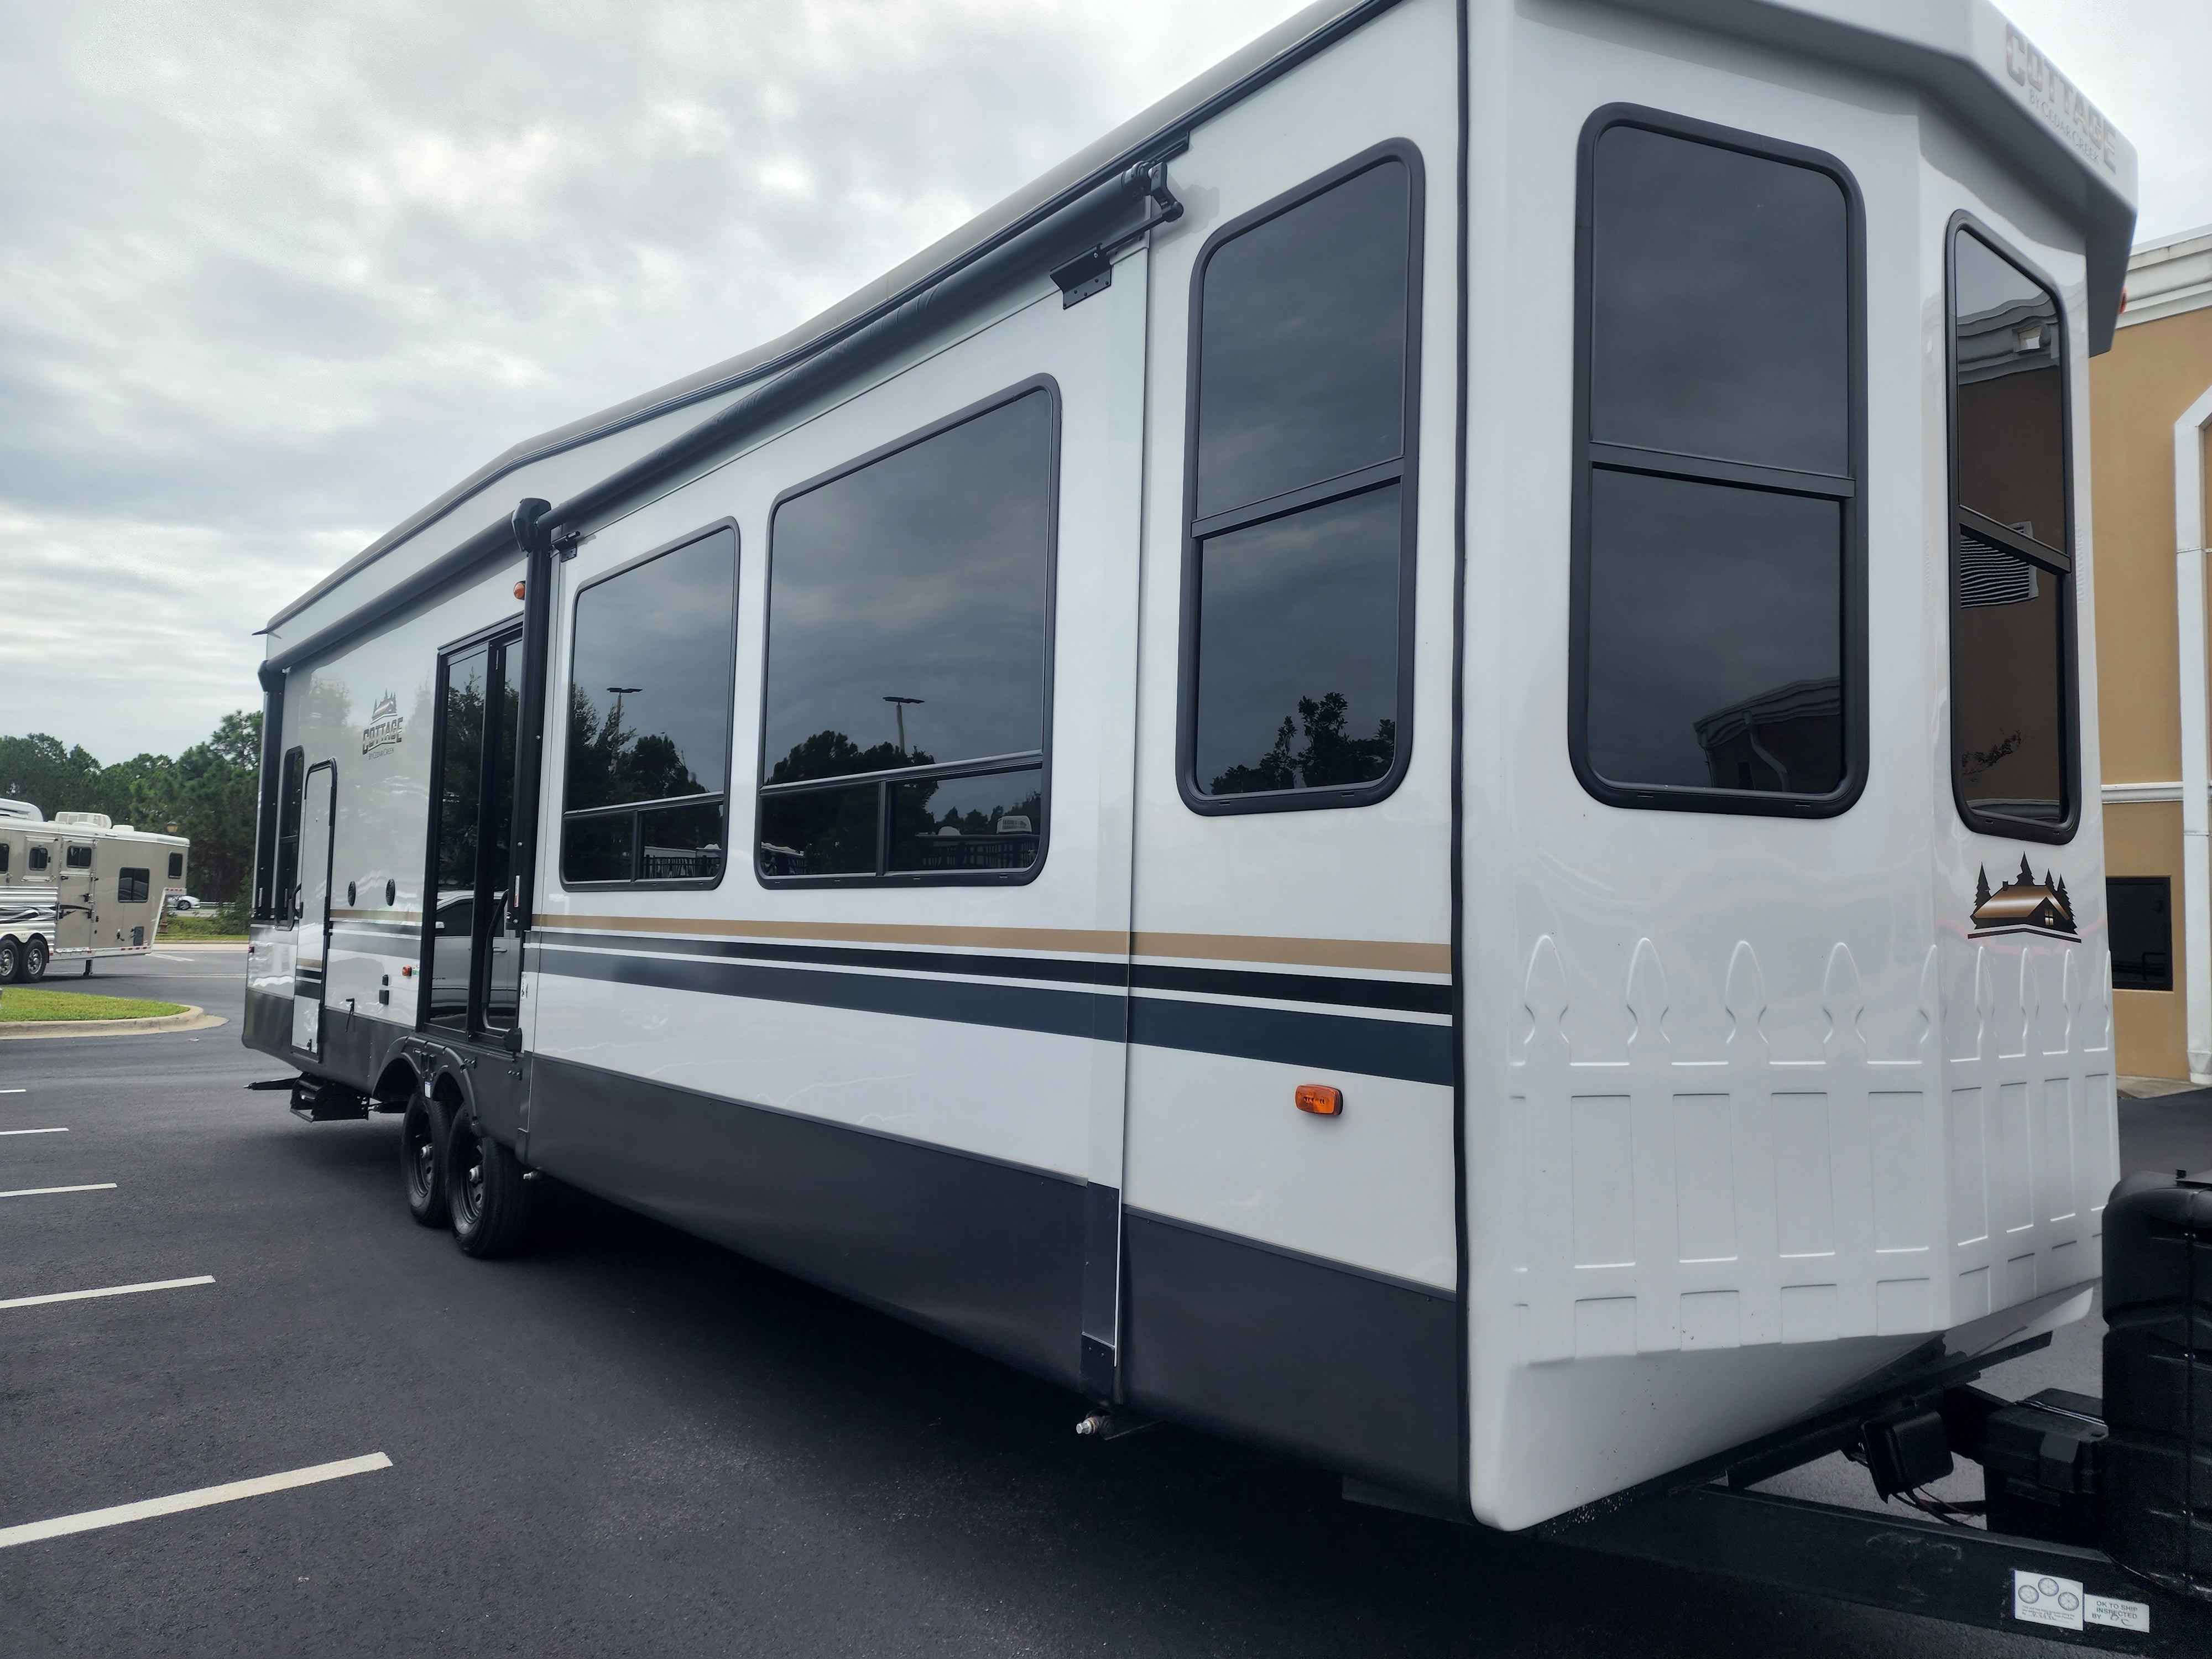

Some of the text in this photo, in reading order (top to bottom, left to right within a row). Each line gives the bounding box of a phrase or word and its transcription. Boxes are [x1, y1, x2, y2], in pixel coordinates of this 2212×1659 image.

[2005, 23, 2116, 175] COTTAGE
[2029, 88, 2100, 166] BY CEDAR CREEK
[362, 717, 403, 755] COTTAGE
[384, 747, 394, 756] CREEK
[2096, 1608, 2137, 1619] INSPECTED
